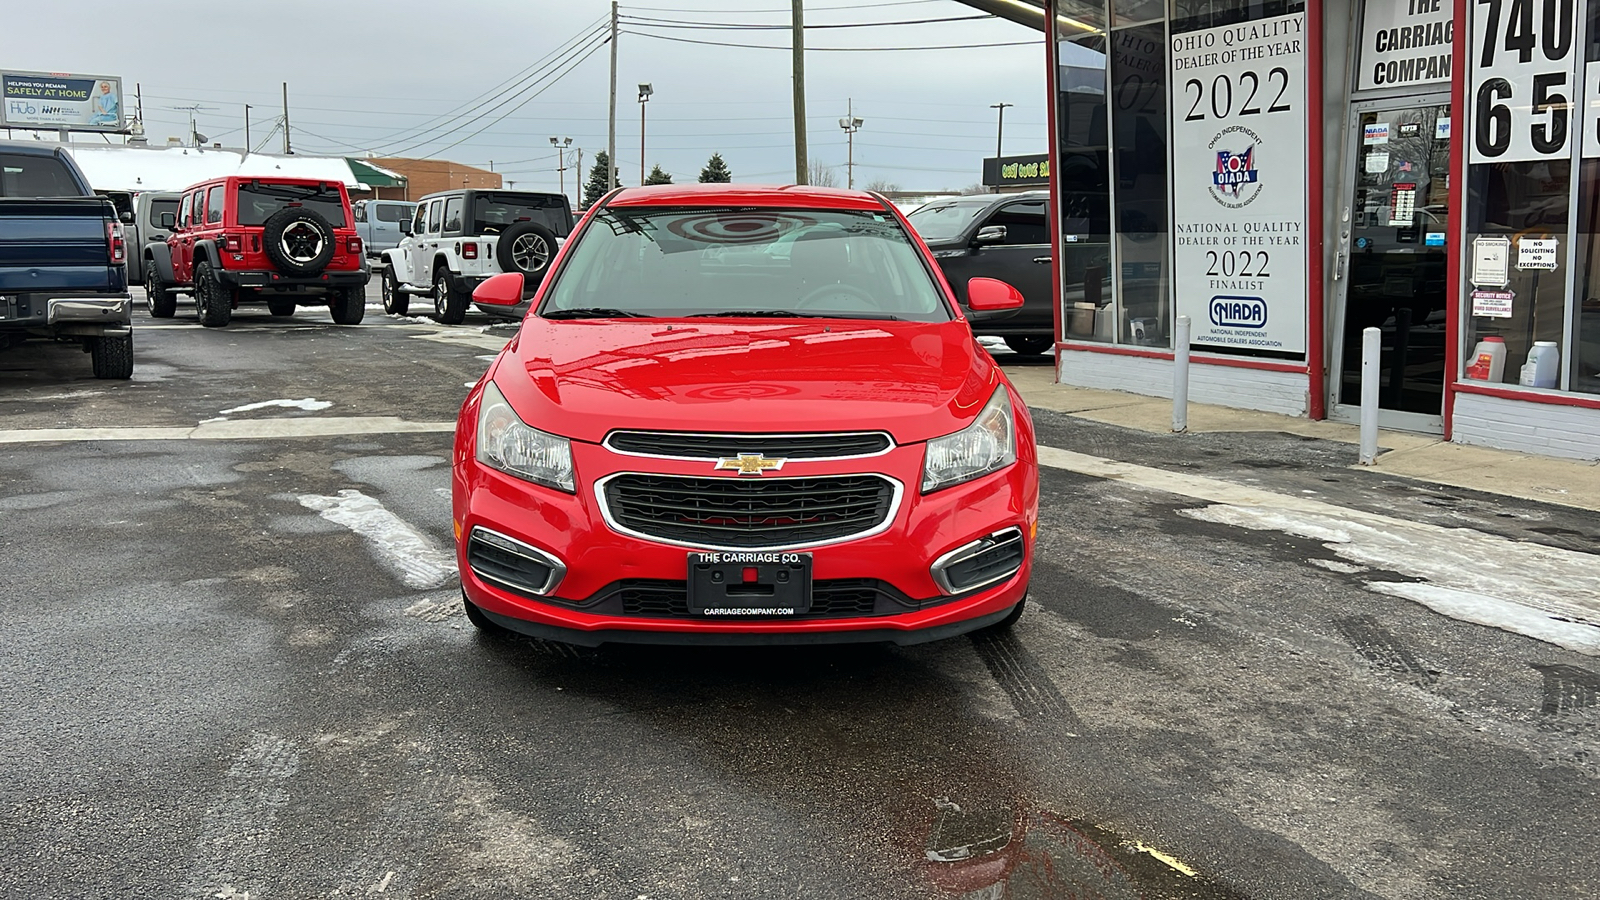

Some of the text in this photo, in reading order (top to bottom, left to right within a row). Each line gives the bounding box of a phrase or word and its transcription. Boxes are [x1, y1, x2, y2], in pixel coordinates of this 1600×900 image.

[1408, 0, 1441, 16] THE
[1173, 17, 1303, 53] OHIO QUALITY
[1375, 19, 1454, 53] CARRIAG
[1477, 0, 1573, 69] 740
[1175, 39, 1301, 71] DEALER OF THE YEAR
[1373, 54, 1453, 85] COMPAN
[7, 87, 42, 96] SAFELY
[59, 90, 87, 98] HOME
[1184, 66, 1291, 122] 2022
[10, 102, 36, 114] Hub
[1208, 125, 1263, 150] OHIO INDEPENDENT
[1217, 171, 1250, 184] OIADA
[1208, 186, 1227, 207] AUTOMOBILE
[1243, 183, 1264, 207] ASSOCIATION
[1177, 221, 1302, 235] NATIONAL QUALITY
[1178, 236, 1300, 246] DEALER OF THE YEAR
[1205, 250, 1270, 278] 2022
[1210, 280, 1264, 290] FINALIST
[1213, 302, 1262, 321] NIADA
[1248, 339, 1282, 347] ASSOCIATION
[698, 553, 801, 564] THE CARRIAGE CO.
